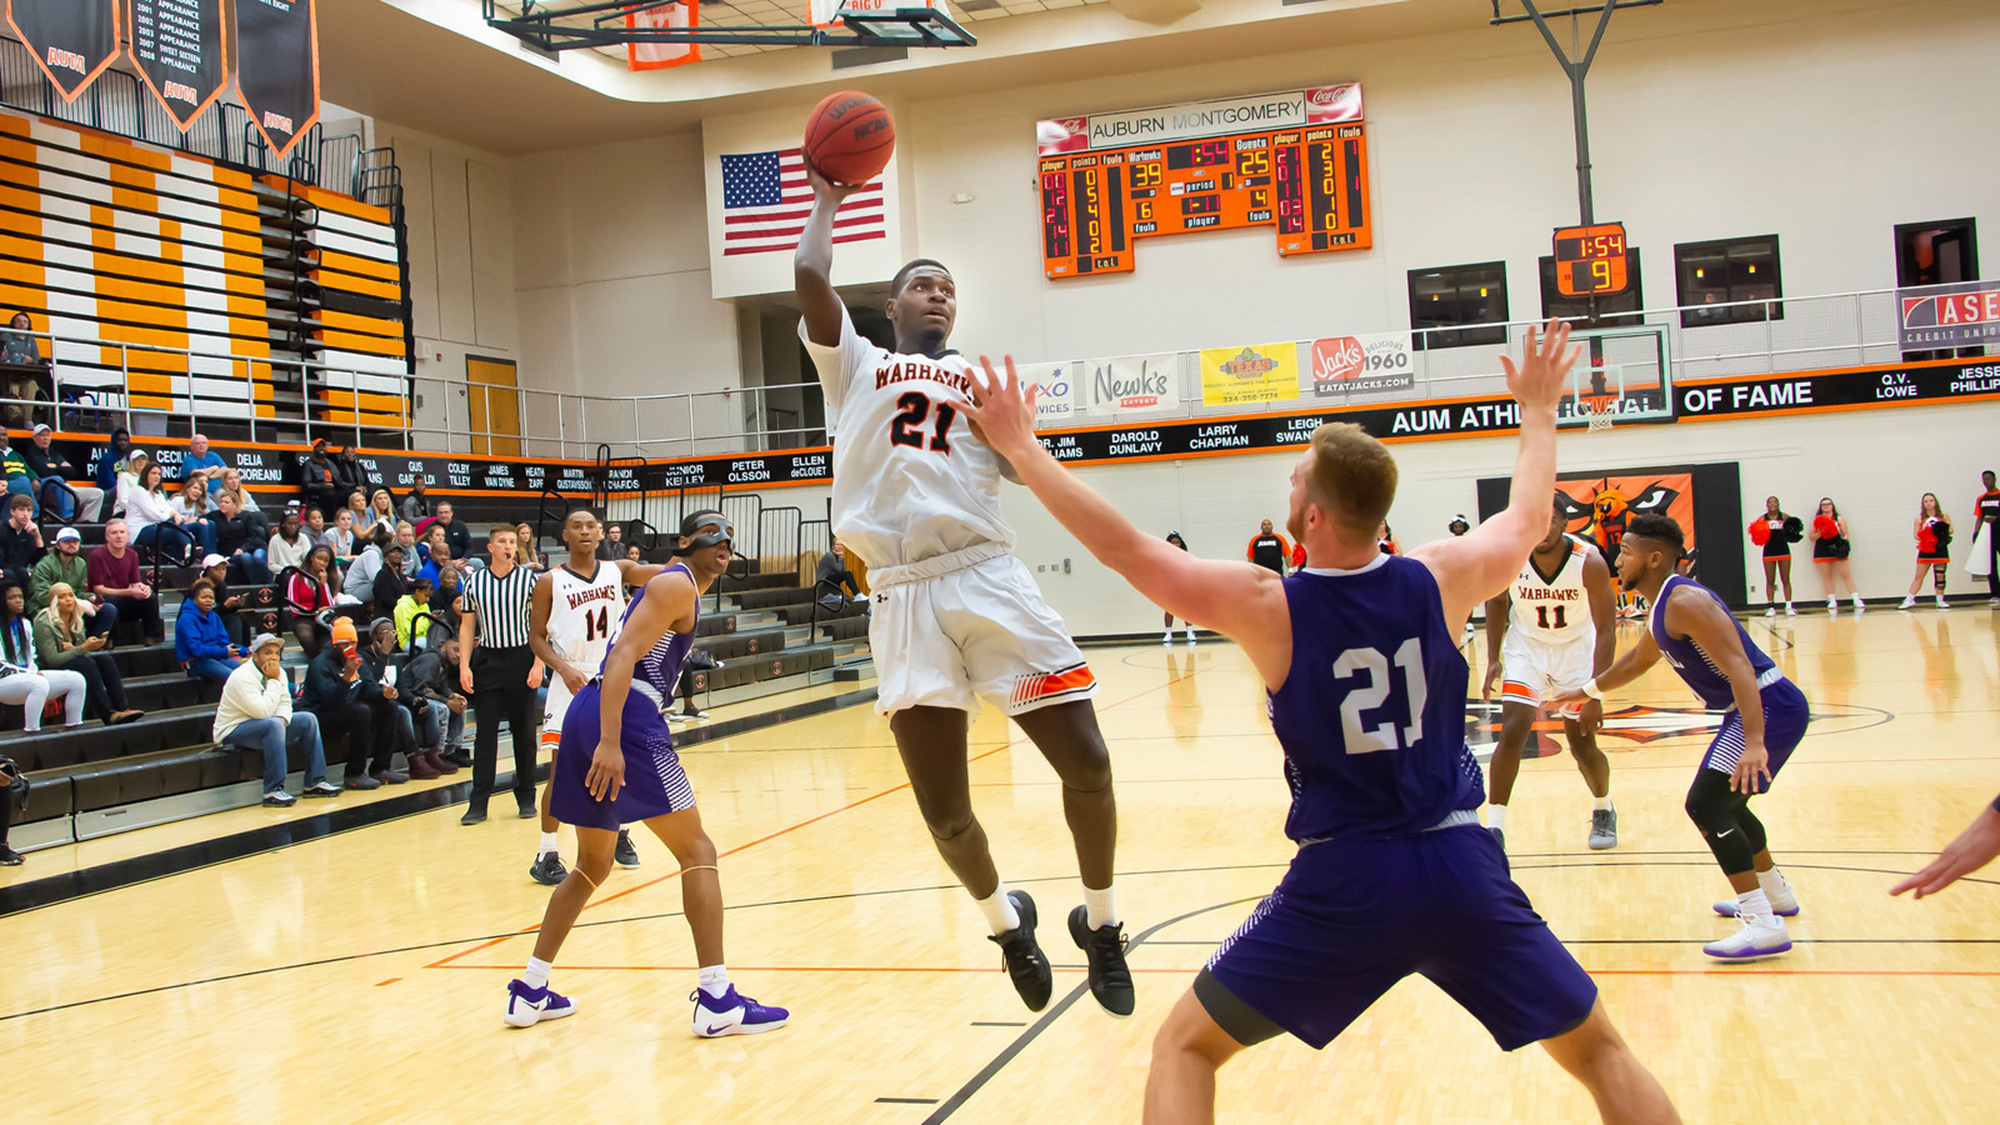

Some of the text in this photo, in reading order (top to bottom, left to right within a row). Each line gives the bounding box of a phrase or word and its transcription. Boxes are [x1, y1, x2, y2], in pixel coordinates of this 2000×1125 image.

[48, 46, 86, 76] AUM
[163, 80, 199, 107] AUM
[263, 110, 294, 136] AUM
[1093, 100, 1303, 140] AUBURN MONTGOMERY
[1274, 134, 1299, 145] player
[1307, 130, 1333, 142] points
[1340, 127, 1361, 138] fouls
[1236, 139, 1267, 151] Guests
[1103, 155, 1123, 165] fouls
[1191, 142, 1229, 165] 1:54
[1277, 147, 1299, 164] 21
[1322, 143, 1332, 159] 2
[1042, 161, 1065, 172] player
[1073, 157, 1097, 168] points
[1241, 151, 1269, 175] 25
[1324, 160, 1333, 177] 3
[1044, 169, 1096, 190] 00 0
[1136, 162, 1162, 186] 39
[1186, 180, 1214, 192] period
[1324, 178, 1334, 194] 0
[1087, 186, 1097, 203] 5
[1255, 190, 1266, 205] 4
[1088, 204, 1098, 218] 4
[1141, 202, 1152, 218] 6
[1250, 211, 1270, 221] fouls
[1089, 220, 1099, 236] 0
[1136, 223, 1155, 233] fouls
[1188, 216, 1216, 228] player
[1326, 213, 1336, 230] 0
[1090, 237, 1100, 253] 2
[1581, 235, 1622, 257] 1:54
[1592, 260, 1610, 289] 9
[1943, 293, 1999, 324] ASE
[1907, 326, 2000, 343] CREDIT UNIO
[1365, 340, 1404, 354] DELICIOUS
[1315, 338, 1361, 379] Jack's
[1363, 352, 1408, 371] 1960
[1227, 358, 1271, 374] TEXAS
[1958, 365, 2000, 380] JESSE
[1095, 360, 1168, 405] Newk's
[1319, 378, 1409, 393] EATATJACKS.COM
[1881, 373, 1911, 386] Q.V.
[1951, 379, 2000, 393] PHILLIP
[1876, 385, 1918, 399] LOWE
[1123, 397, 1155, 405] EATERY
[1392, 408, 1450, 433] AUM
[1684, 388, 1723, 412] OF
[1732, 381, 1814, 409] FAME
[891, 391, 957, 457] 21
[1288, 418, 1323, 431] LEIGH
[1111, 431, 1159, 444] DAROLD
[1198, 425, 1237, 438] LARRY
[1057, 437, 1076, 448] JIM
[1109, 442, 1162, 456] DUNLAVY
[1189, 436, 1249, 450] CHAPMAN
[236, 453, 263, 466] DELIA
[1050, 447, 1083, 459] LIAMS
[408, 461, 424, 472] GUS
[732, 460, 764, 471] PETER
[792, 455, 825, 467] ELLEN
[235, 468, 283, 481] CIOREANU
[448, 463, 470, 474] COLBY
[488, 465, 509, 476] JAMES
[525, 467, 545, 477] HEATH
[563, 468, 584, 478] MARTIN
[666, 464, 704, 476] JUNIOR
[790, 466, 827, 478] deCLOUET
[398, 473, 436, 485] GARLDI
[449, 475, 471, 486] TILLEY
[484, 477, 515, 488] VAN DYNE
[528, 478, 544, 488] ZAPF
[728, 470, 771, 482] OLSSON
[557, 480, 593, 490] GUSTAVSSON
[603, 479, 640, 490] ICHARDS
[566, 584, 616, 610] WARHAWKS
[1518, 586, 1579, 601] WARHAWKS
[585, 605, 609, 642] 14
[1535, 605, 1568, 630] 11
[1332, 637, 1428, 755] 21
